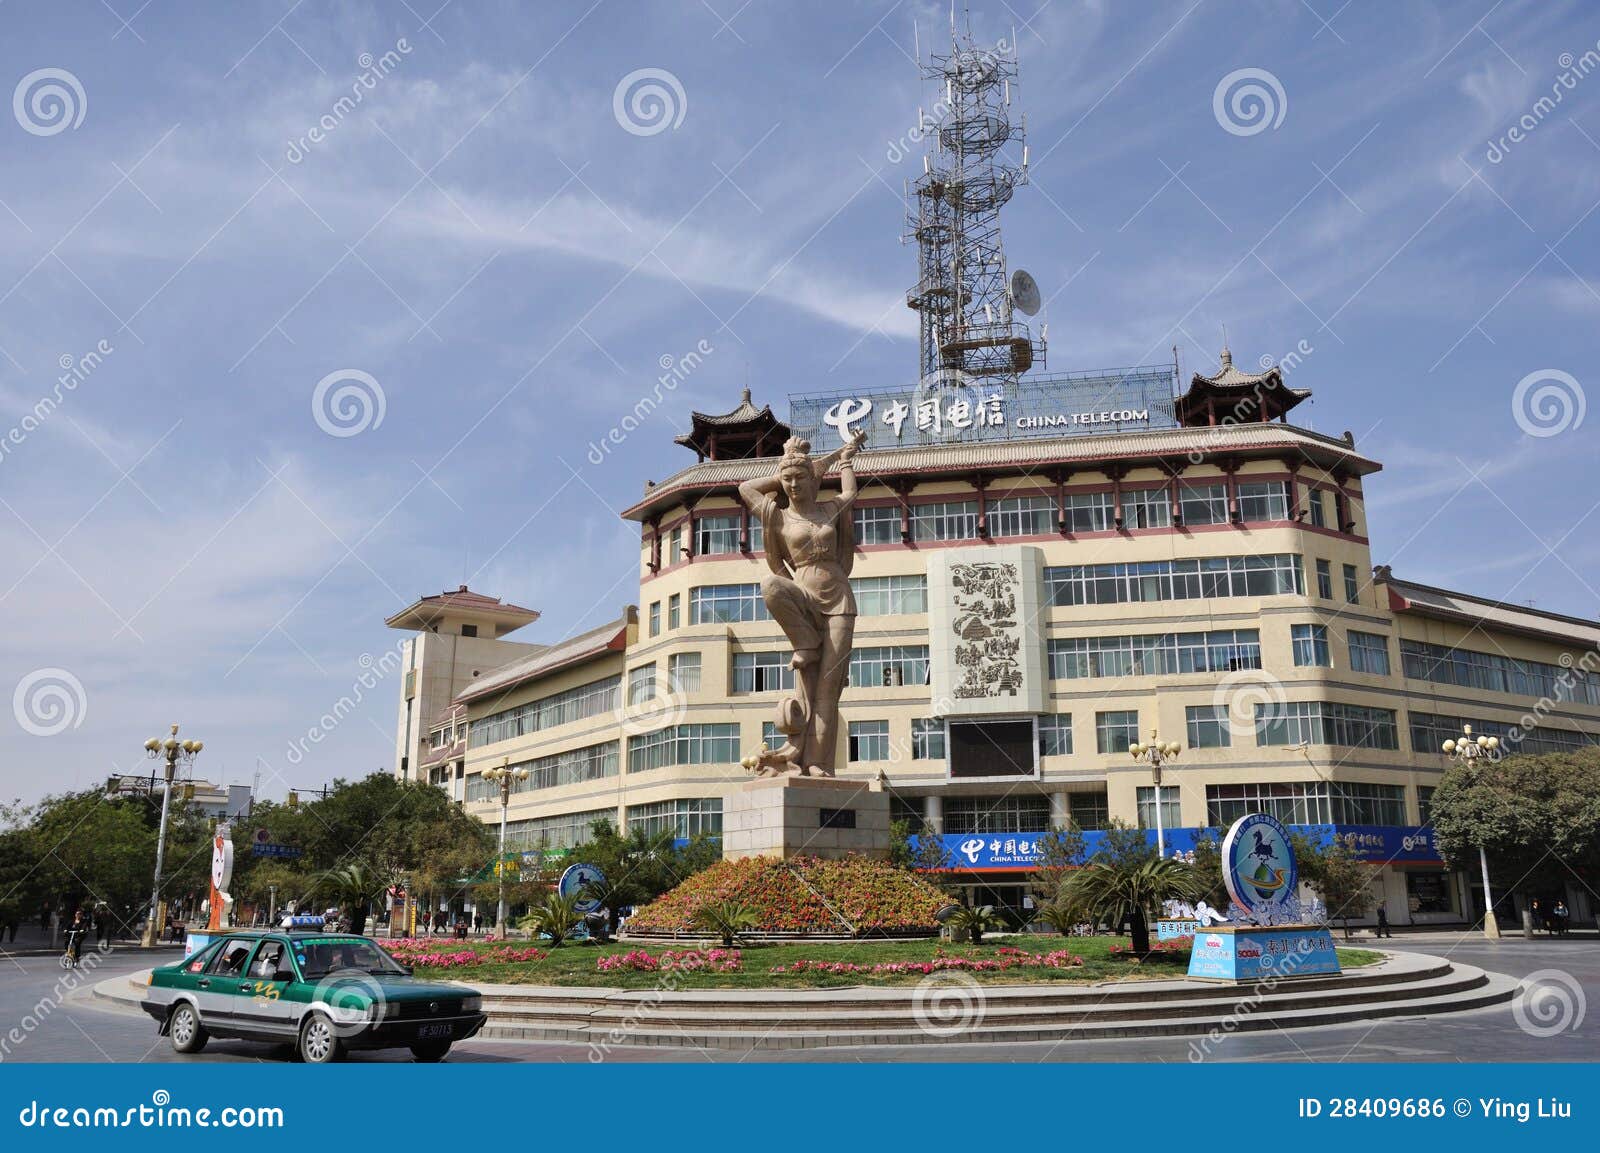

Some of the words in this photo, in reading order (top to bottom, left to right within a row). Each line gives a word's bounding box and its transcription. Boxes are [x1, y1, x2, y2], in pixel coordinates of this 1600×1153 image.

[882, 394, 1005, 437] 中国电信
[1016, 413, 1068, 428] CHINA
[1071, 409, 1149, 425] TELECOM
[292, 916, 325, 925] TAXI
[1237, 949, 1261, 958] SOGAL
